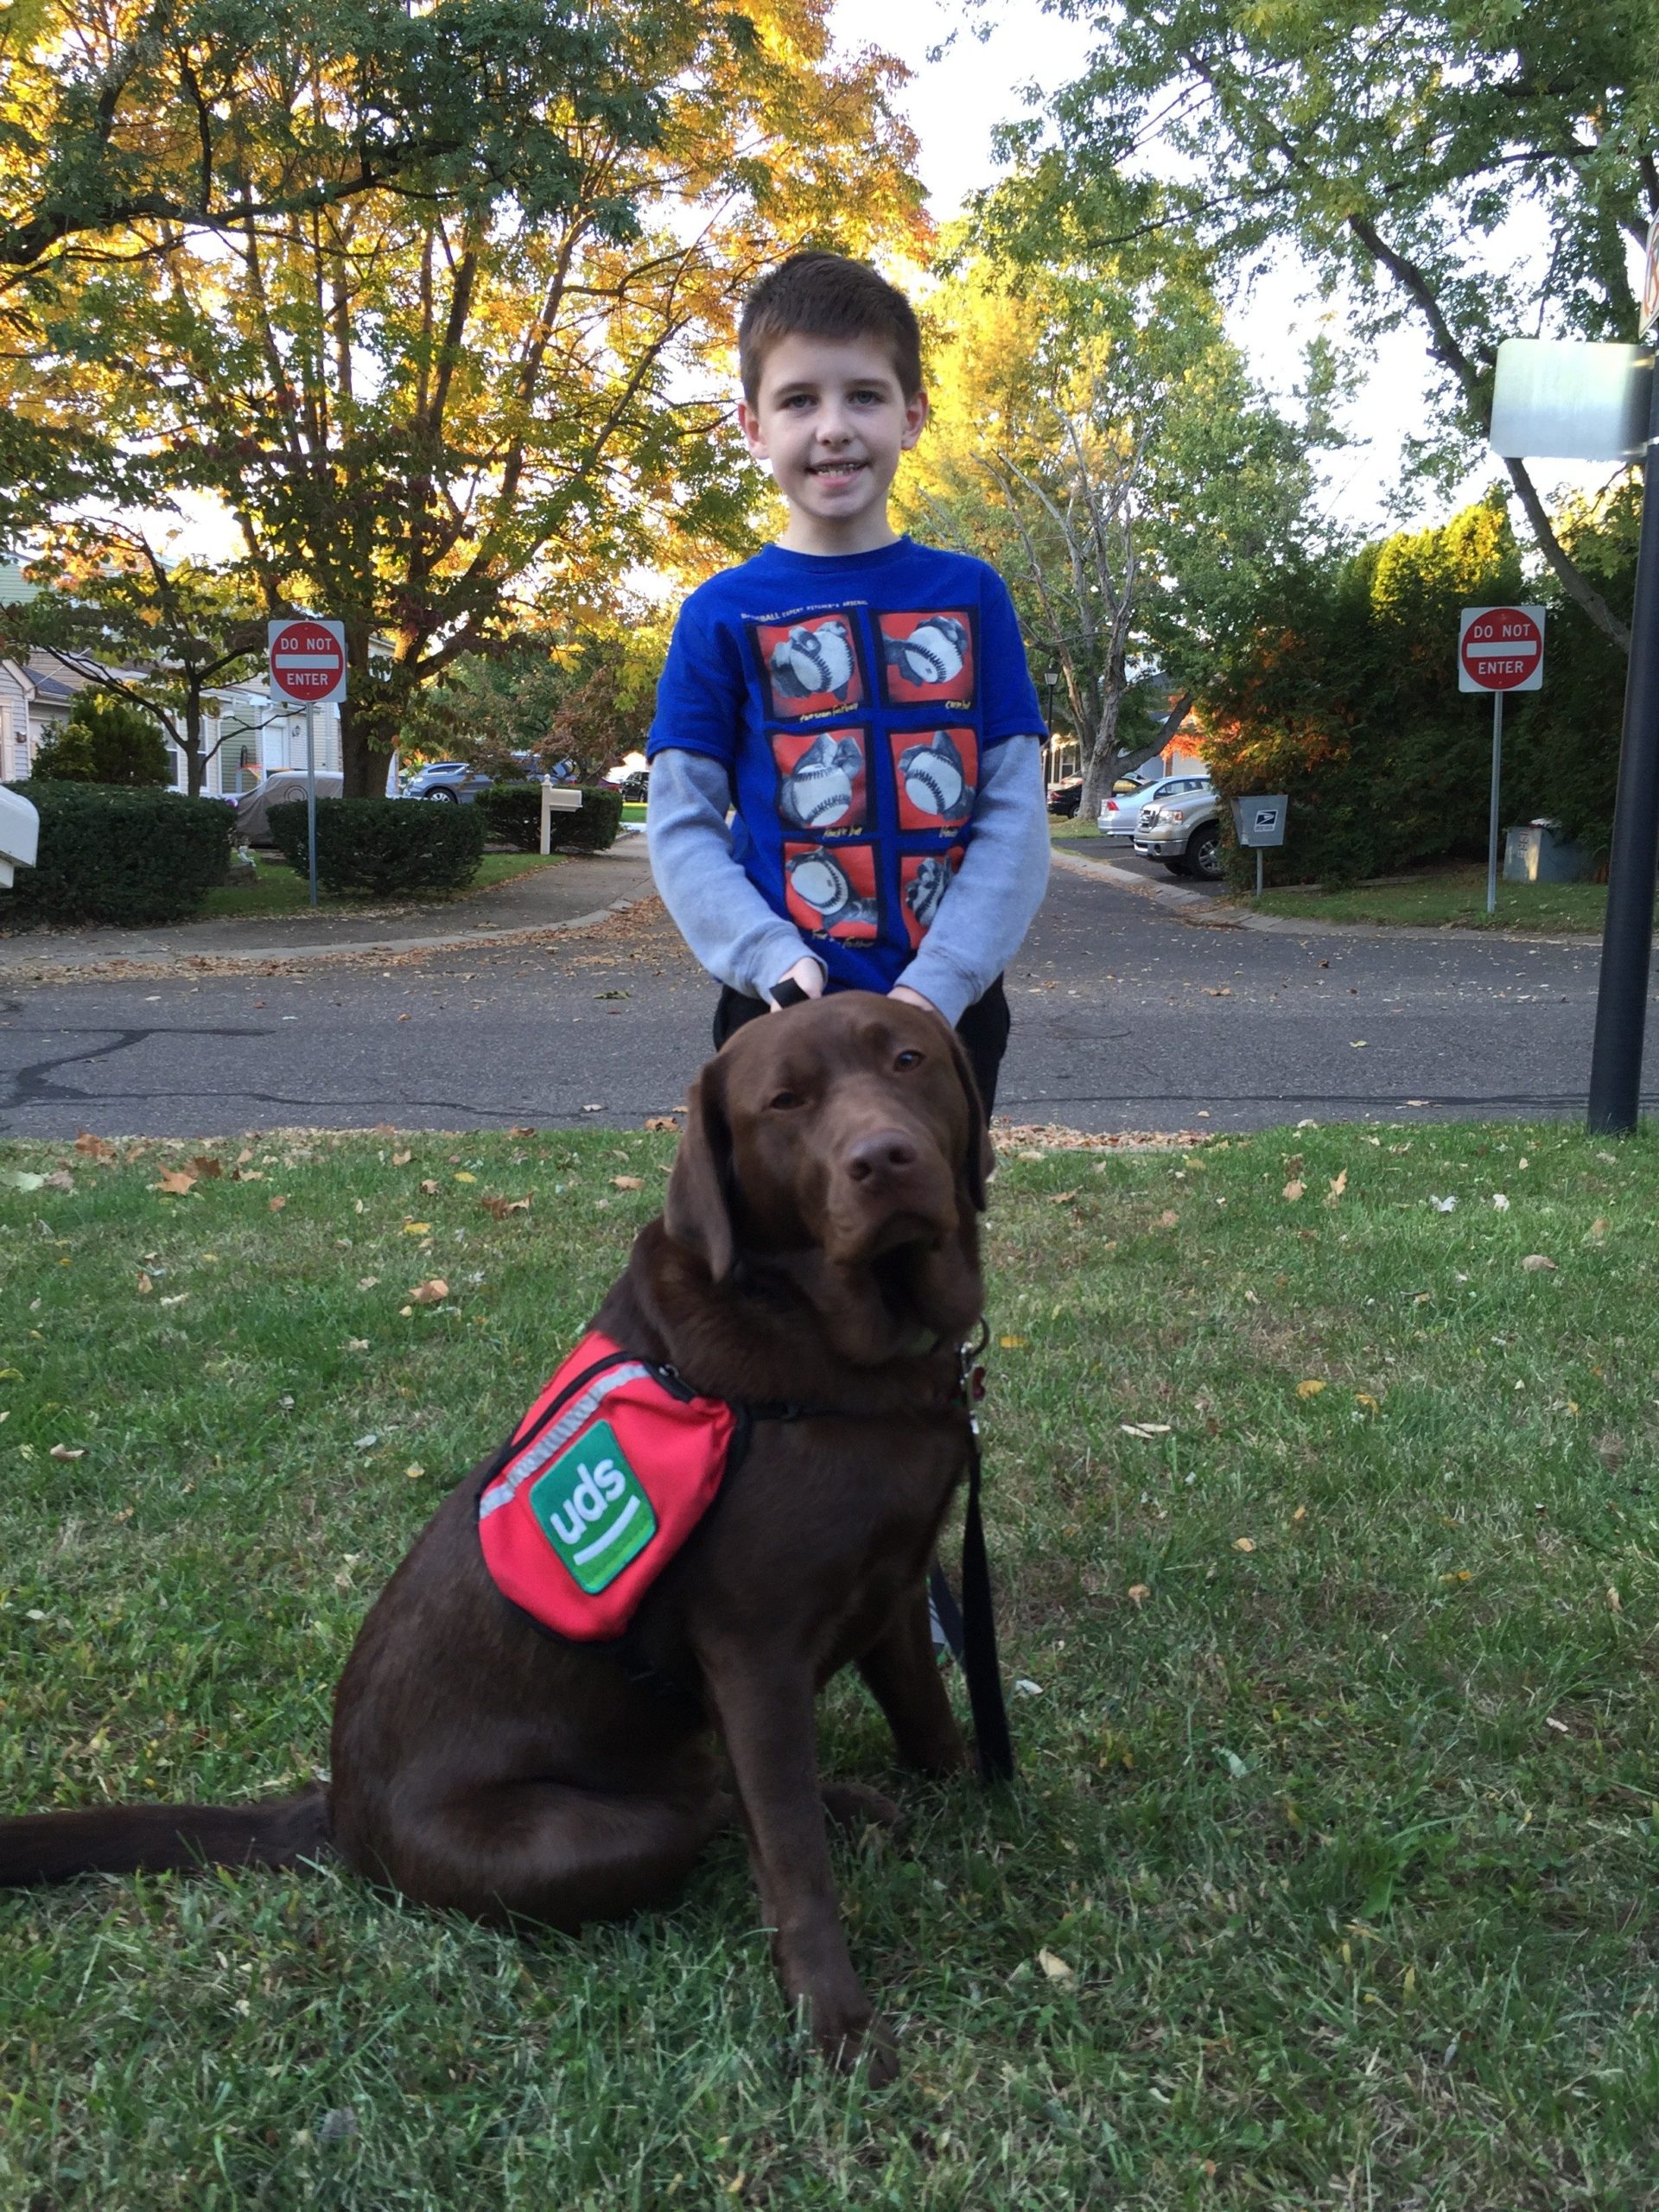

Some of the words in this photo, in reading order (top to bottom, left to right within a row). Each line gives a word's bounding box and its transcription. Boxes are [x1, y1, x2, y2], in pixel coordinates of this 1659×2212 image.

[1474, 625, 1493, 639] DO
[1502, 623, 1531, 638] NOT
[281, 638, 299, 651] DO
[307, 638, 333, 651] NOT
[1478, 661, 1524, 675] ENTER
[286, 673, 328, 686] ENTER
[549, 1458, 626, 1545] uds
